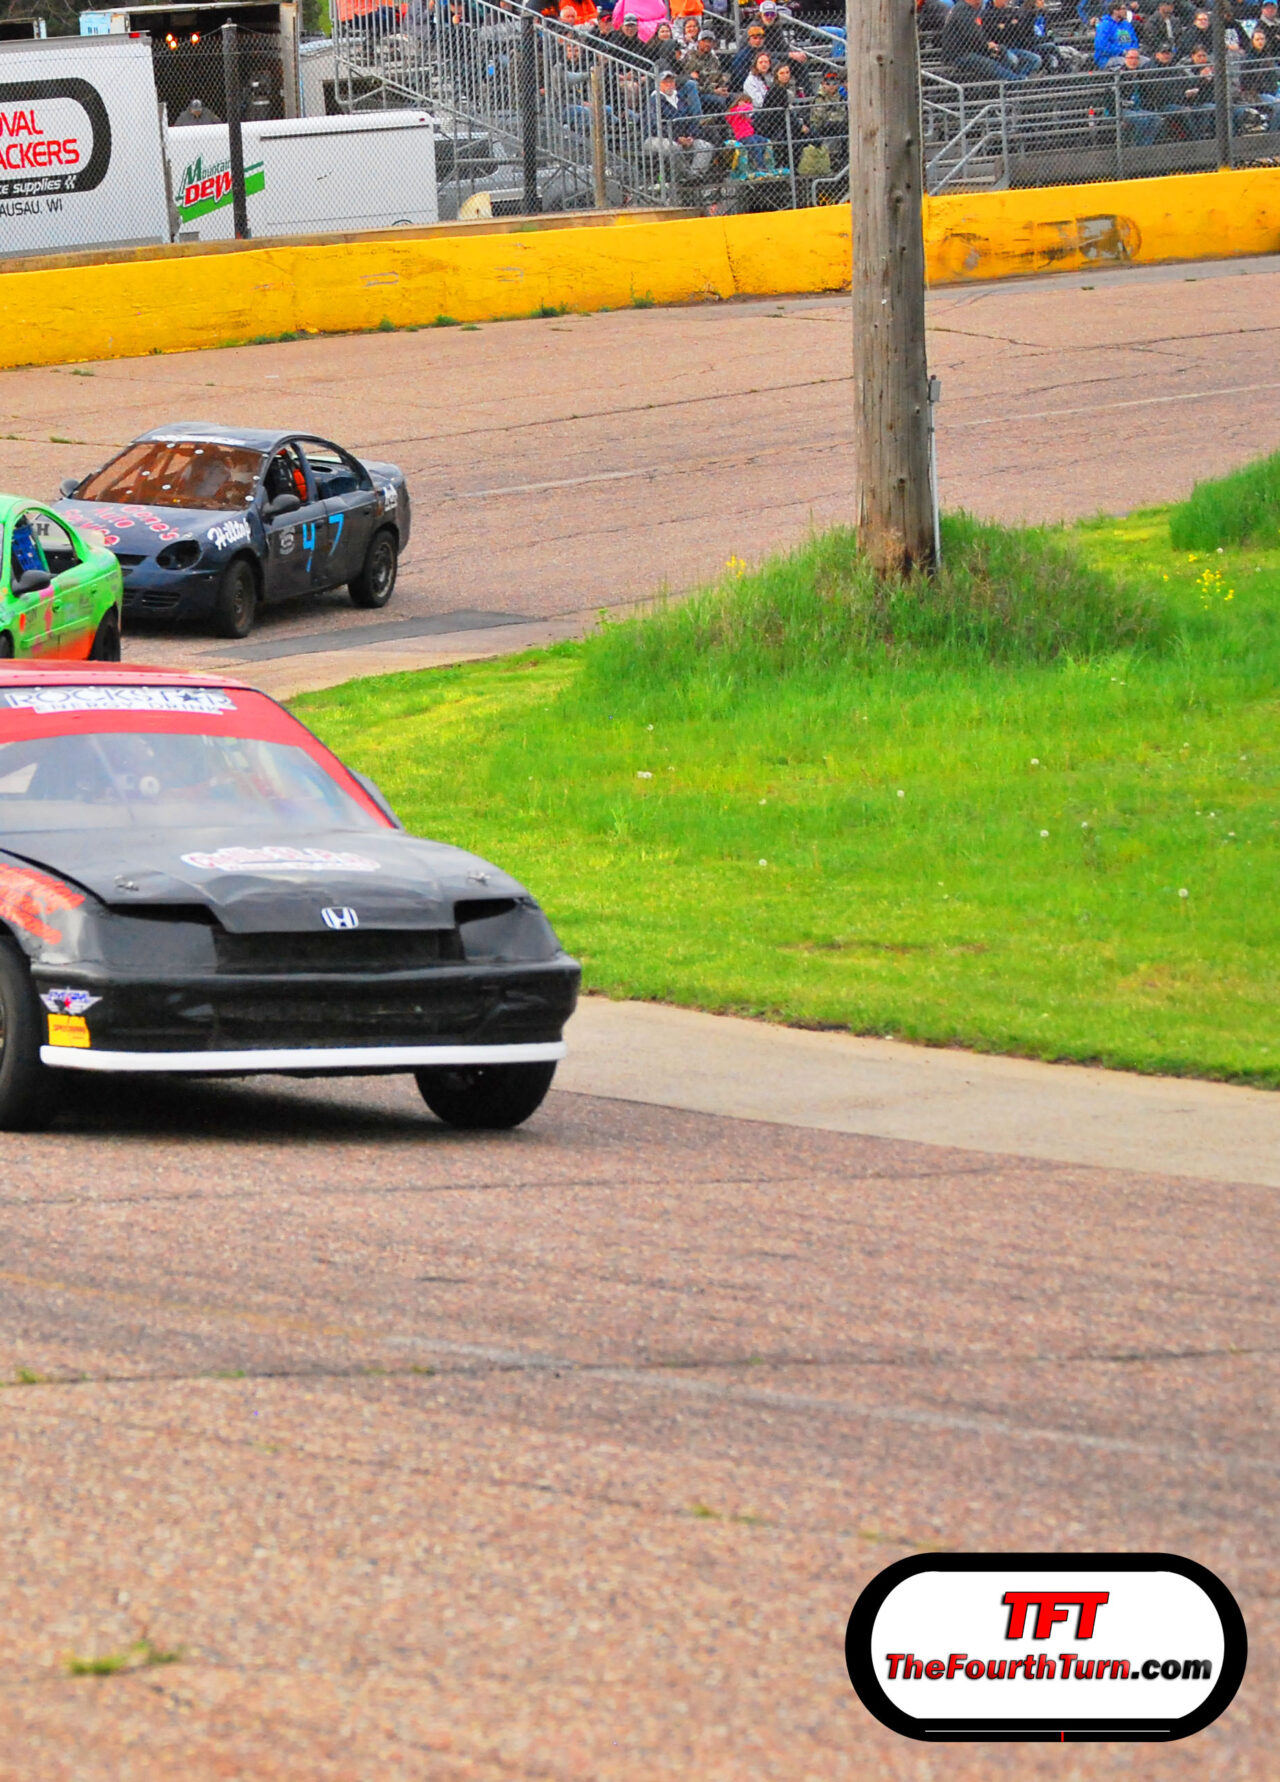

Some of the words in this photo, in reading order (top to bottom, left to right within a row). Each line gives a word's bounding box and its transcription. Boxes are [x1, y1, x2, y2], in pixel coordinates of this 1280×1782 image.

[12, 175, 62, 196] supplies
[46, 198, 63, 213] WI
[207, 517, 252, 551] Hilltop
